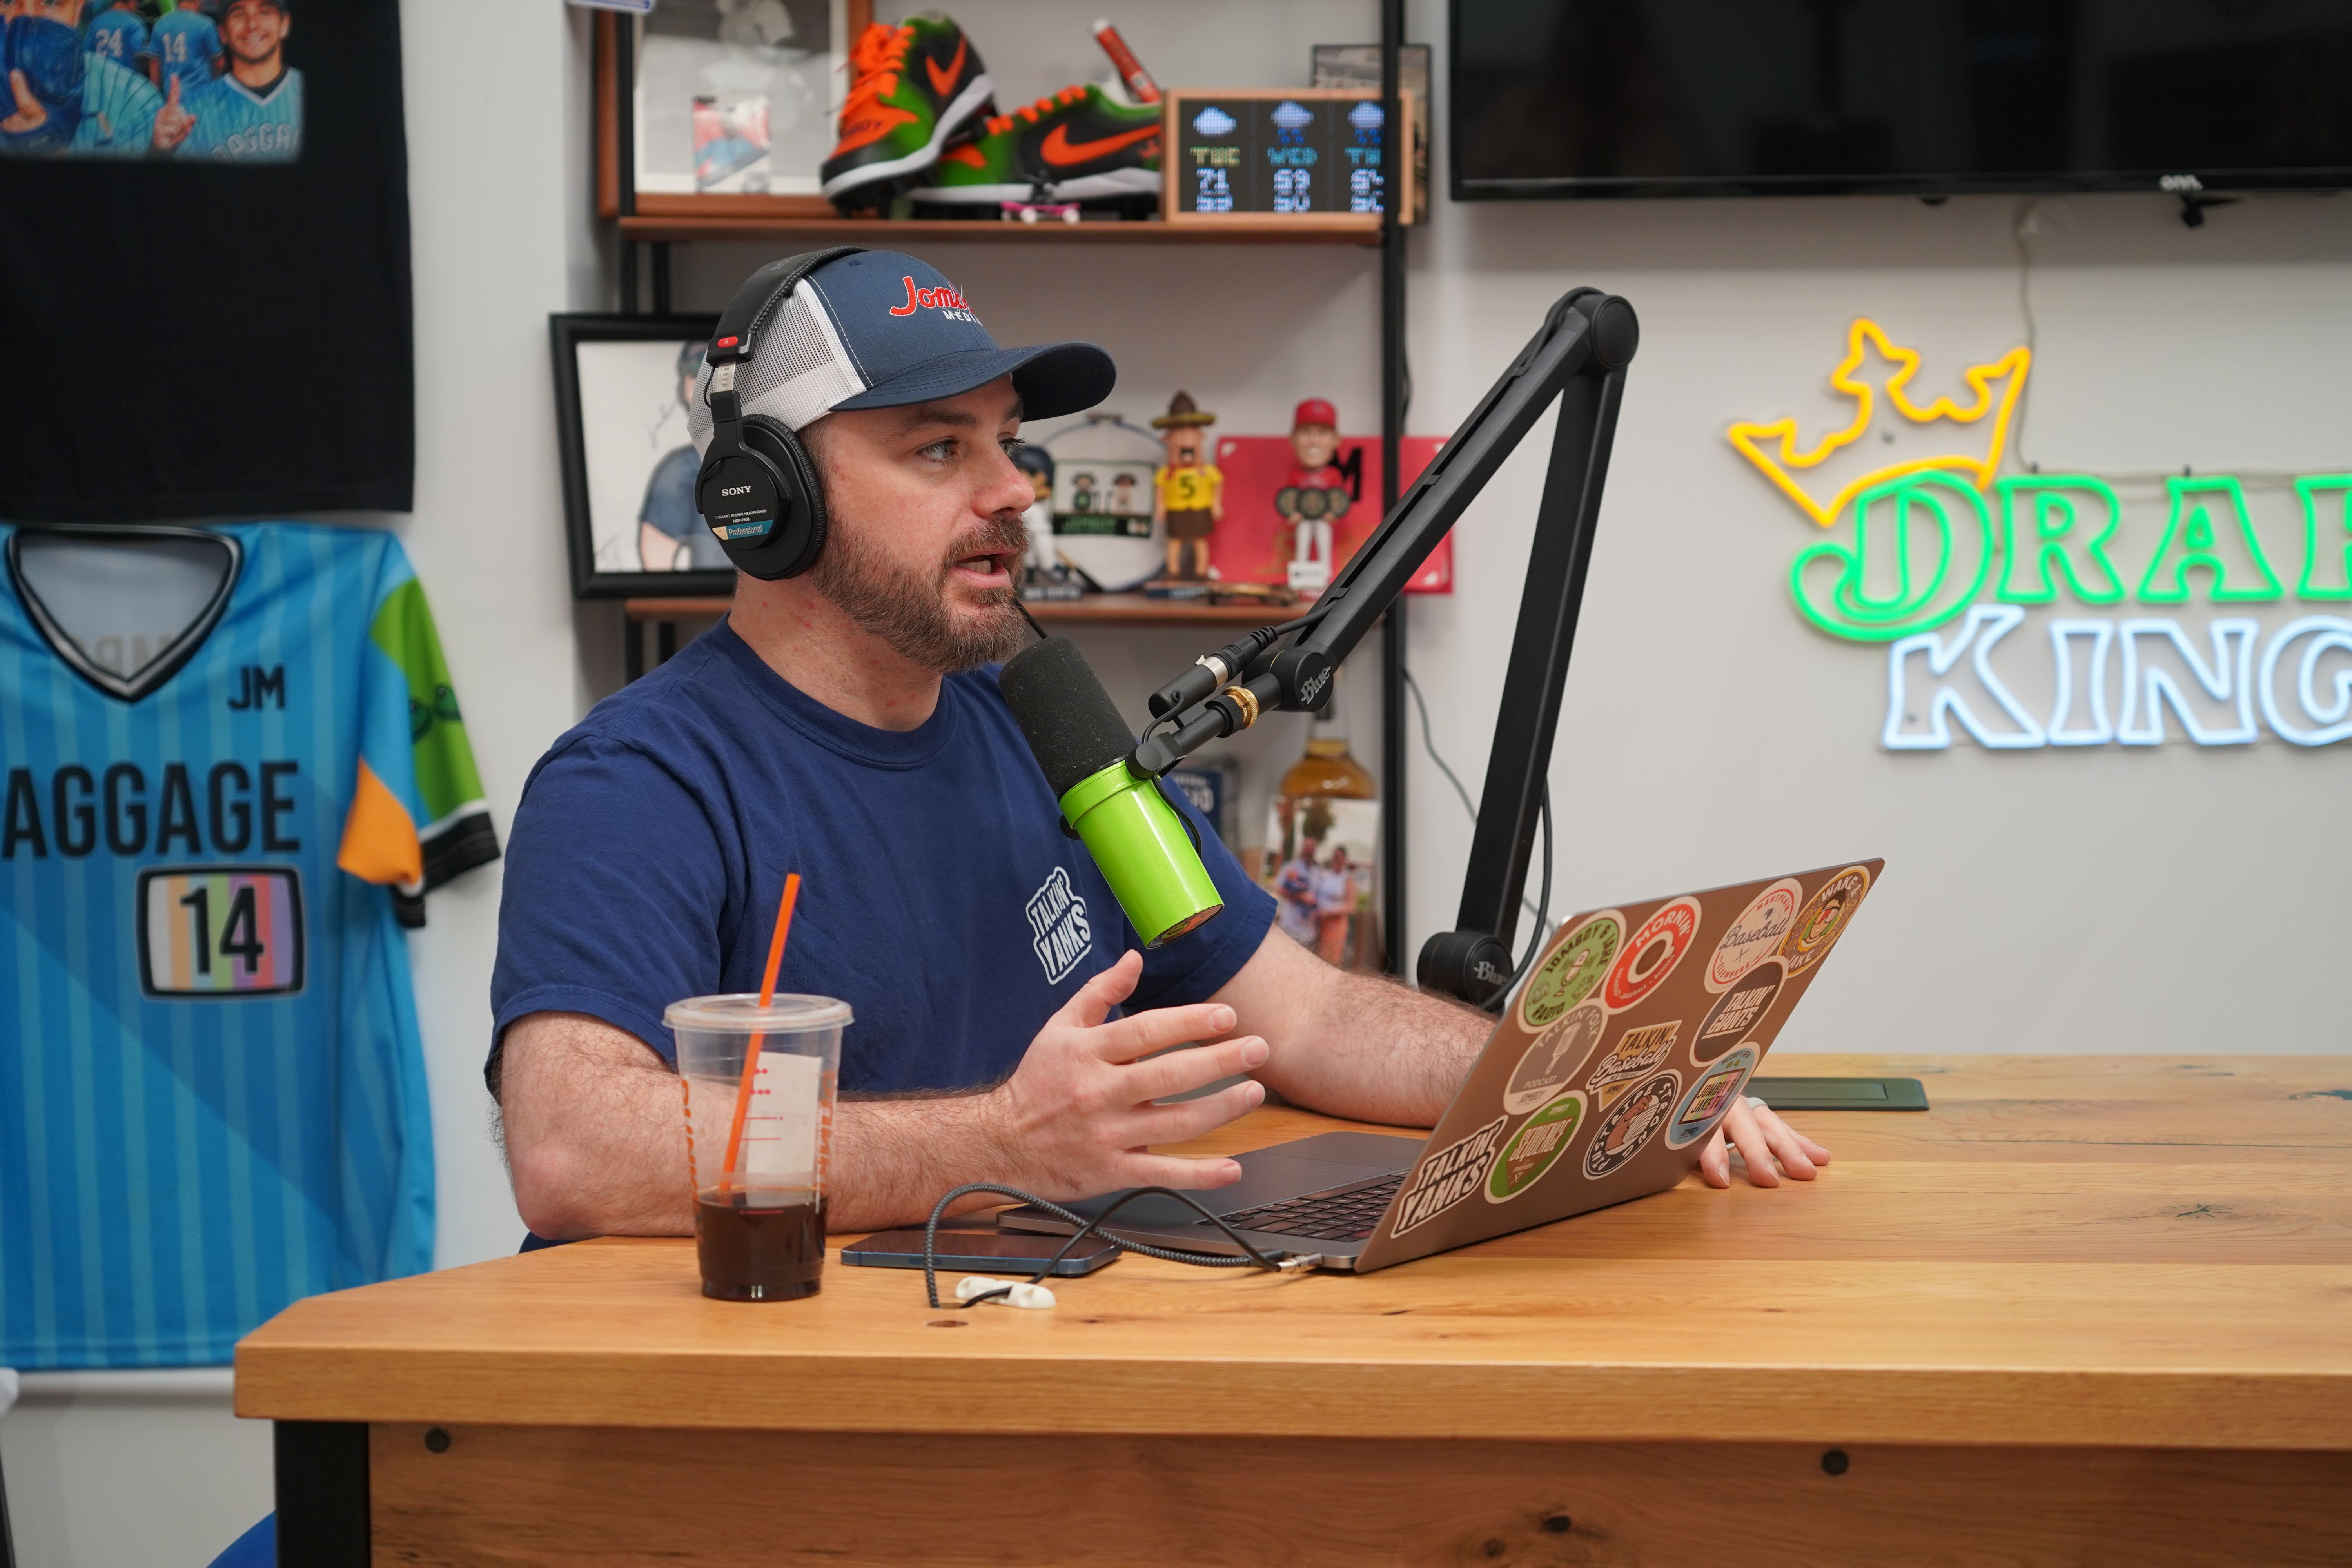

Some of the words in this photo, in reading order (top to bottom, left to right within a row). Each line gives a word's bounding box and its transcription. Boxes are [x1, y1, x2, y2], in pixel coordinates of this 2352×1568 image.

[96, 28, 123, 58] 24
[162, 31, 187, 63] 14
[1190, 147, 1240, 167] TUE
[1267, 147, 1318, 167] WED
[1197, 168, 1229, 191] 71
[721, 485, 752, 497] SONY
[1180, 475, 1196, 499] 5
[728, 524, 763, 537] Professional
[226, 664, 286, 711] JM
[1301, 666, 1331, 704] Blue
[1882, 603, 2352, 750] KING
[1, 760, 300, 859] AGGAGE
[1756, 893, 1790, 913] MANSPLAIN
[1820, 875, 1859, 902] WAKE
[1851, 884, 1862, 897] &
[1031, 874, 1070, 936] TALKIN'
[180, 885, 265, 976] 14
[1039, 904, 1091, 976] YANKS
[1635, 909, 1691, 948] MORNIN'
[1718, 916, 1791, 951] Baseball
[1545, 924, 1602, 973] JOMBOY
[1654, 954, 1676, 979] BOOKS
[1716, 961, 1750, 979] ELSEWHERE
[1722, 984, 1776, 1013] TALKIN'
[1587, 1009, 1601, 1040] FOLK
[1706, 1006, 1760, 1034] GIANTS
[1621, 1025, 1675, 1052] TALKIN'
[1590, 1039, 1673, 1085] Baseball
[1617, 1071, 1639, 1080] PODCAST
[1523, 1075, 1558, 1089] PODCAST
[1696, 1079, 1732, 1100] JOMBOY
[1690, 1097, 1715, 1114] JAKE
[1710, 1095, 1724, 1109] TV
[1591, 1082, 1657, 1171] PINSTRIPE
[1621, 1083, 1672, 1158] STRONG
[1508, 1118, 1572, 1162] SEQUENCE
[1419, 1123, 1501, 1191] TALKIN'
[1397, 1155, 1489, 1231] YANKS
